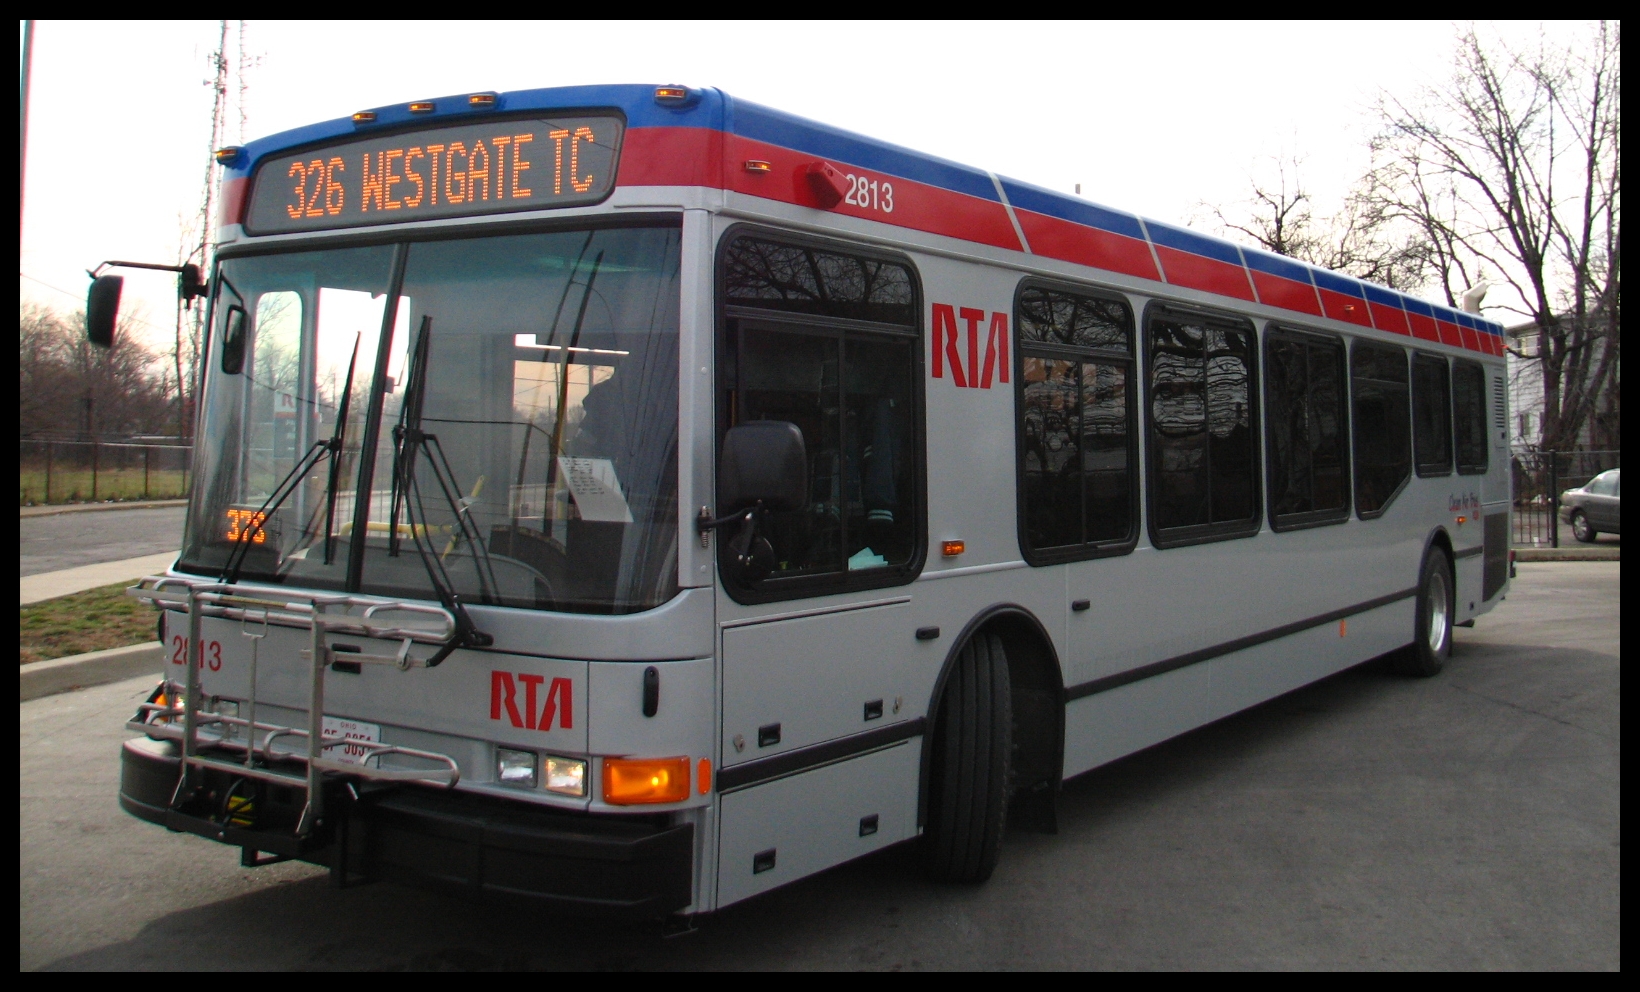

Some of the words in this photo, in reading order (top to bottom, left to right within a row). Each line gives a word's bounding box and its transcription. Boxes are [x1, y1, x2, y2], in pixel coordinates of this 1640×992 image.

[287, 156, 345, 219] 326
[361, 133, 534, 213] WESTGATE
[549, 126, 595, 195] TC
[844, 173, 894, 214] 2813
[931, 302, 1010, 390] RTA
[172, 635, 222, 672] 213
[340, 720, 357, 730] OHIO
[490, 669, 573, 732] RTA
